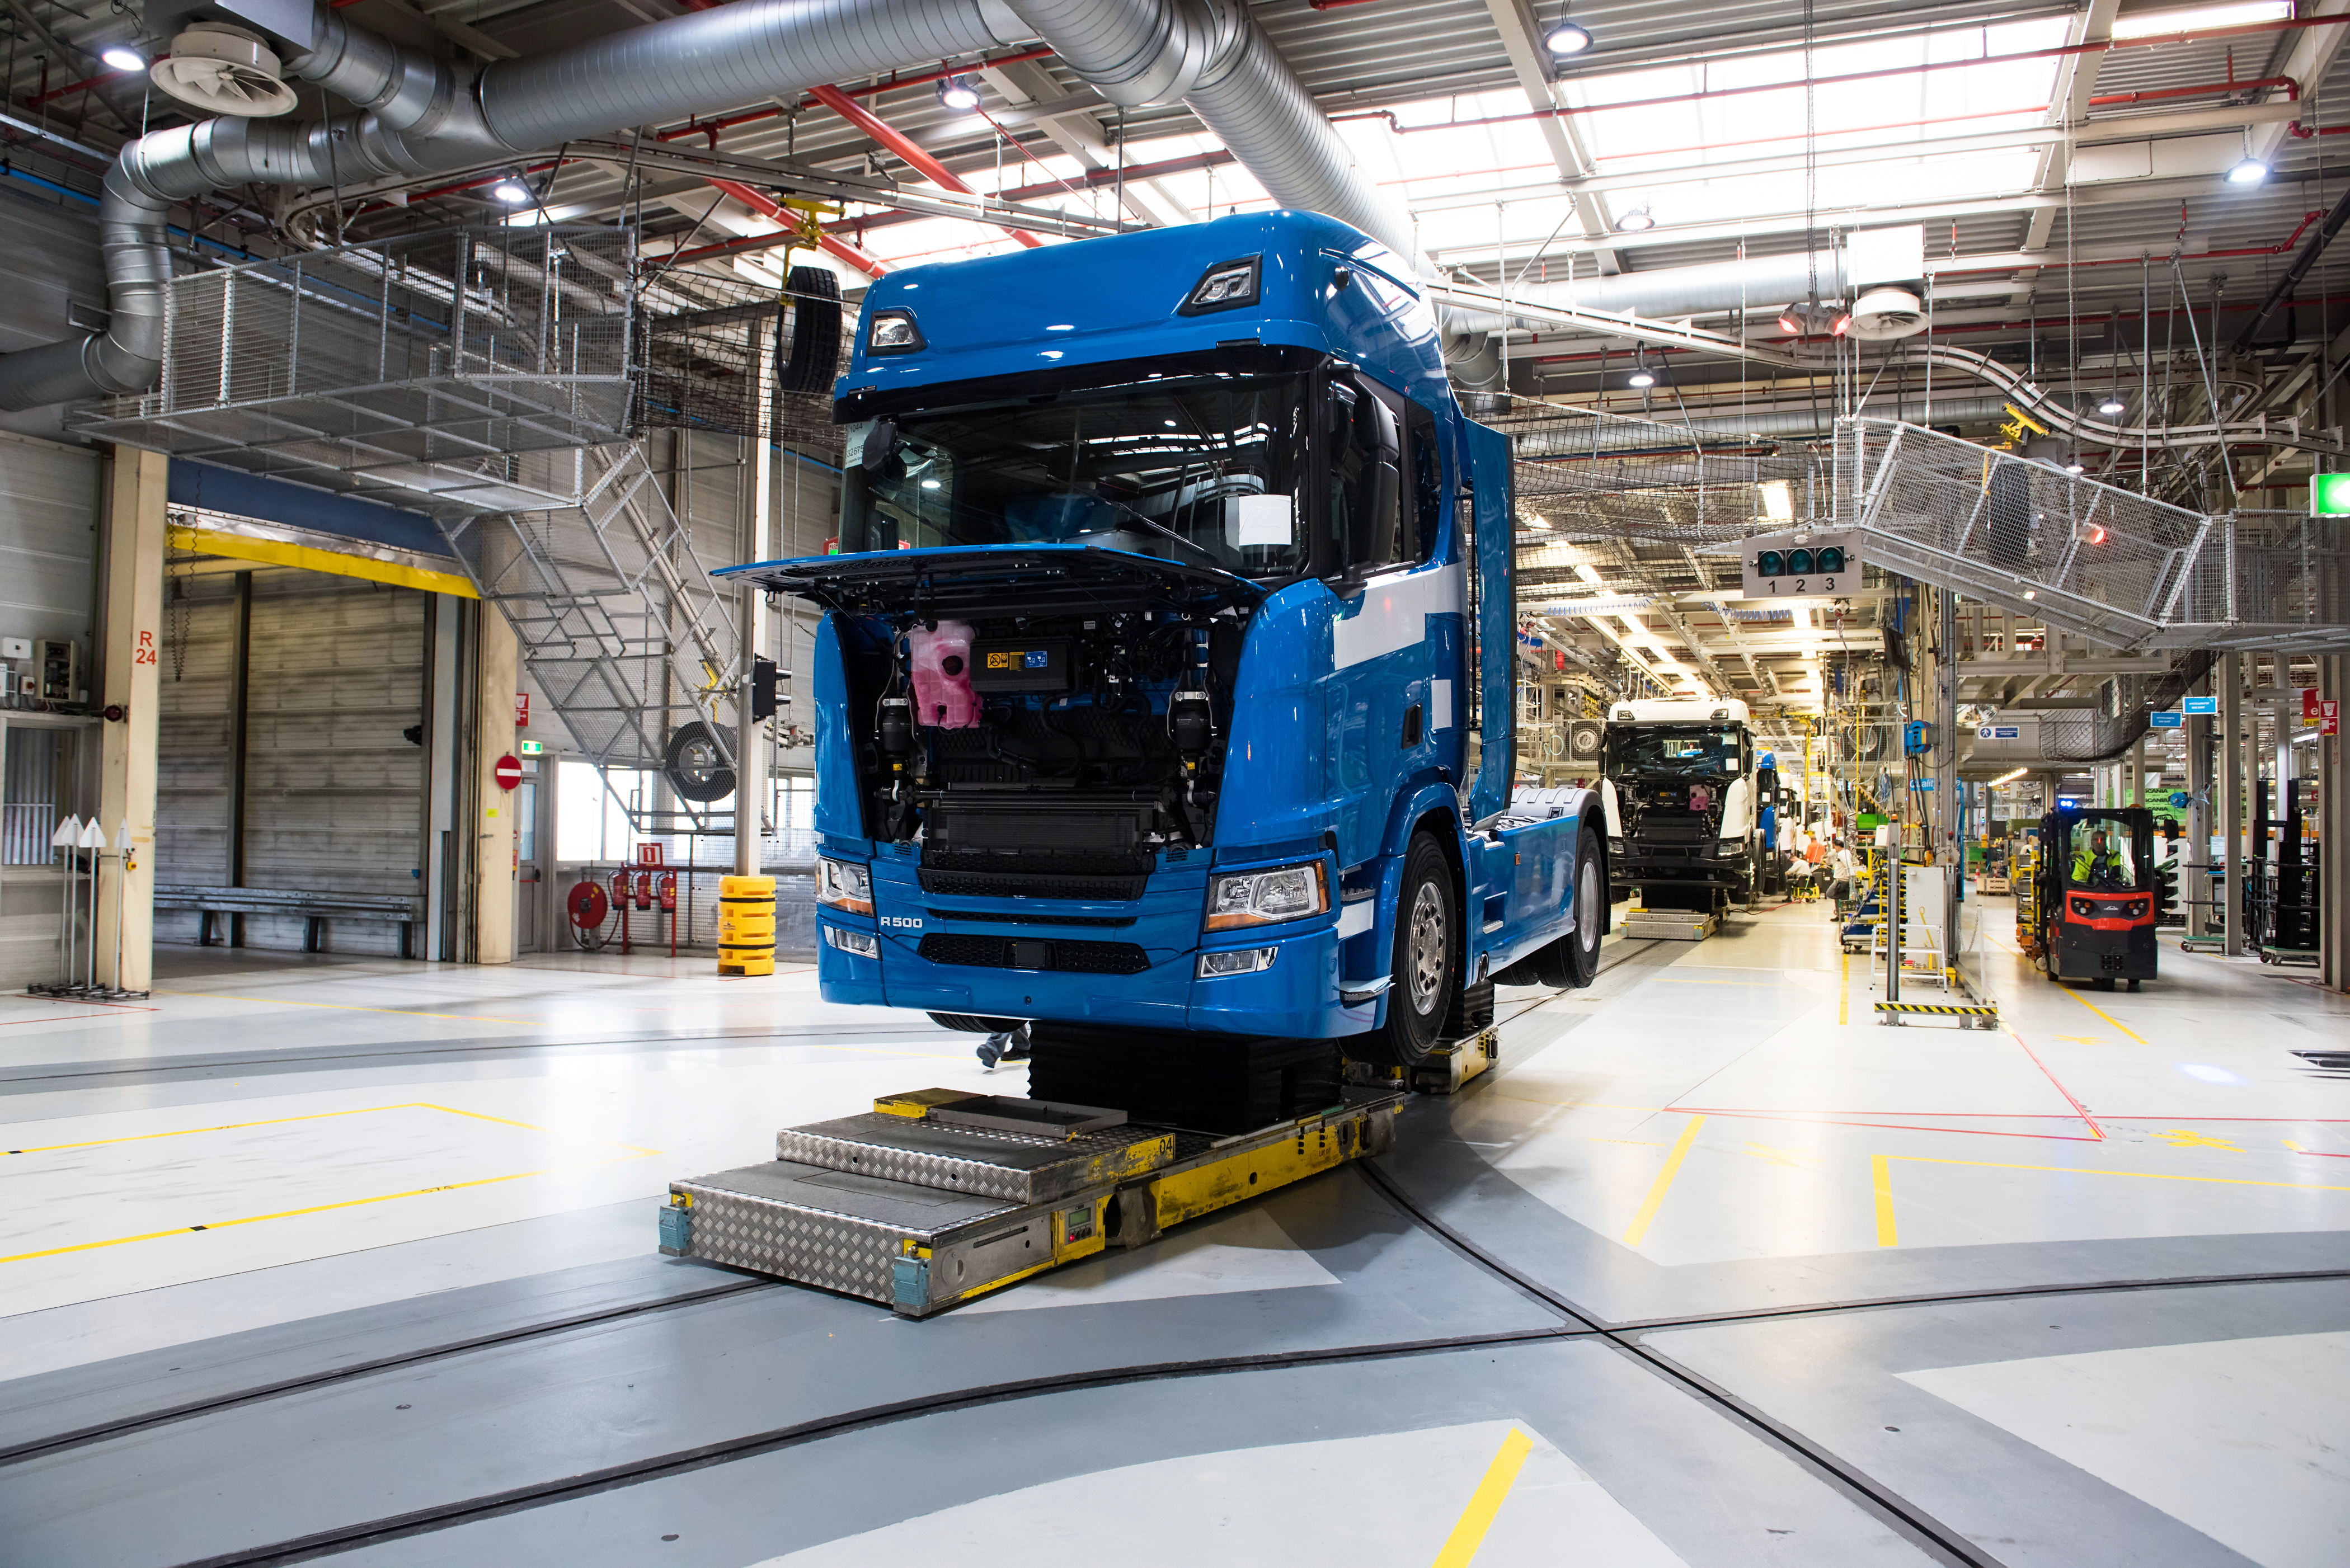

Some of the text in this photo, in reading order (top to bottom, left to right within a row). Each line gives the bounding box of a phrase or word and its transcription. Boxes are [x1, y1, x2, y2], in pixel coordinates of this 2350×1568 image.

[1769, 577, 1835, 593] 1 2 3
[140, 630, 152, 647] R
[136, 648, 157, 665] 24
[881, 916, 923, 928] R 500
[1159, 1137, 1173, 1155] 04
